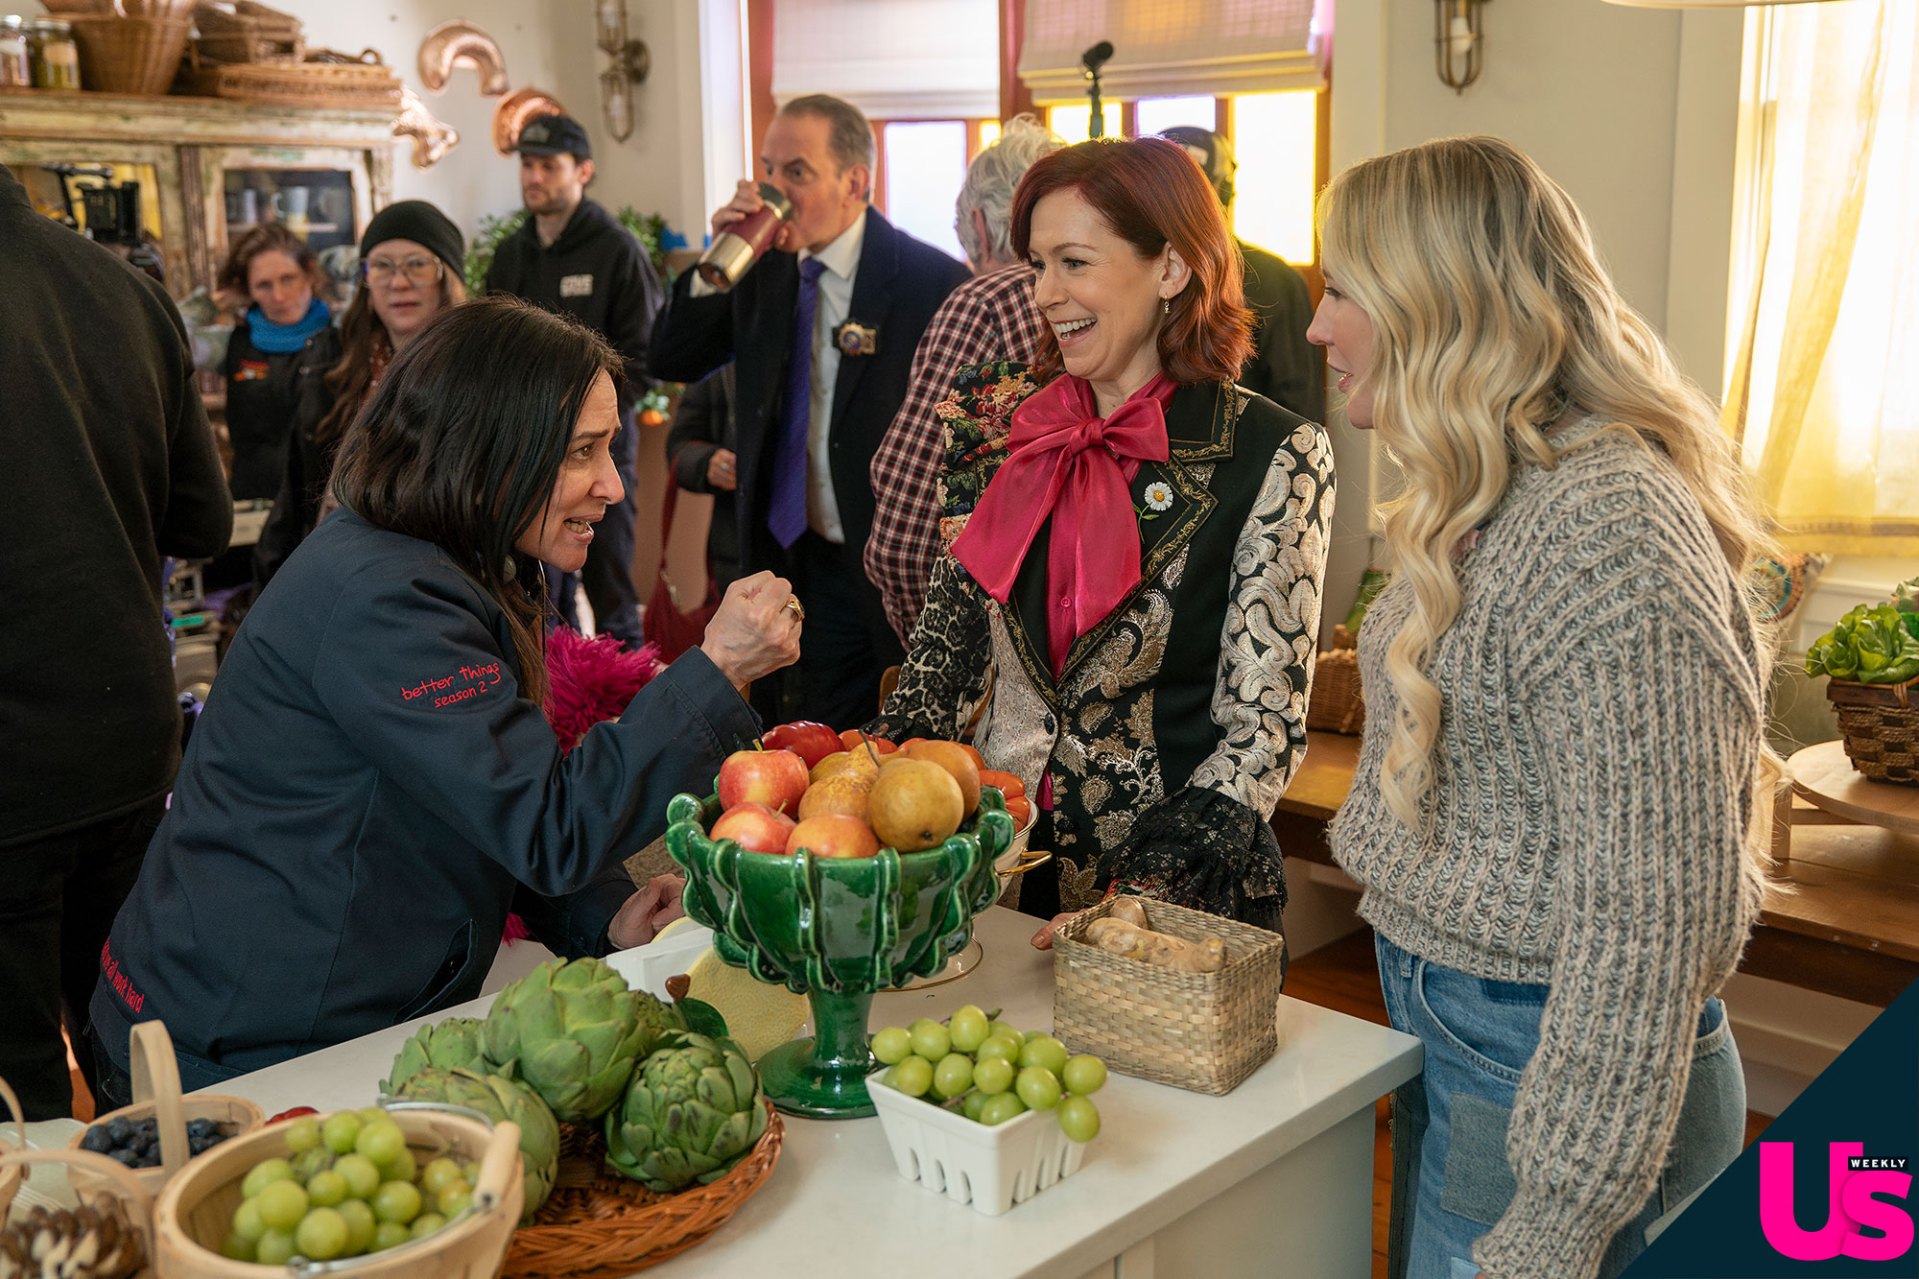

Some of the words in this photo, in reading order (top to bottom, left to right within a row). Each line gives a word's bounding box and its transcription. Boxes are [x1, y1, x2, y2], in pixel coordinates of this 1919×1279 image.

[401, 675, 455, 701] better
[459, 662, 502, 685] things
[434, 687, 477, 709] season
[478, 681, 488, 693] 2
[124, 982, 145, 1013] hard
